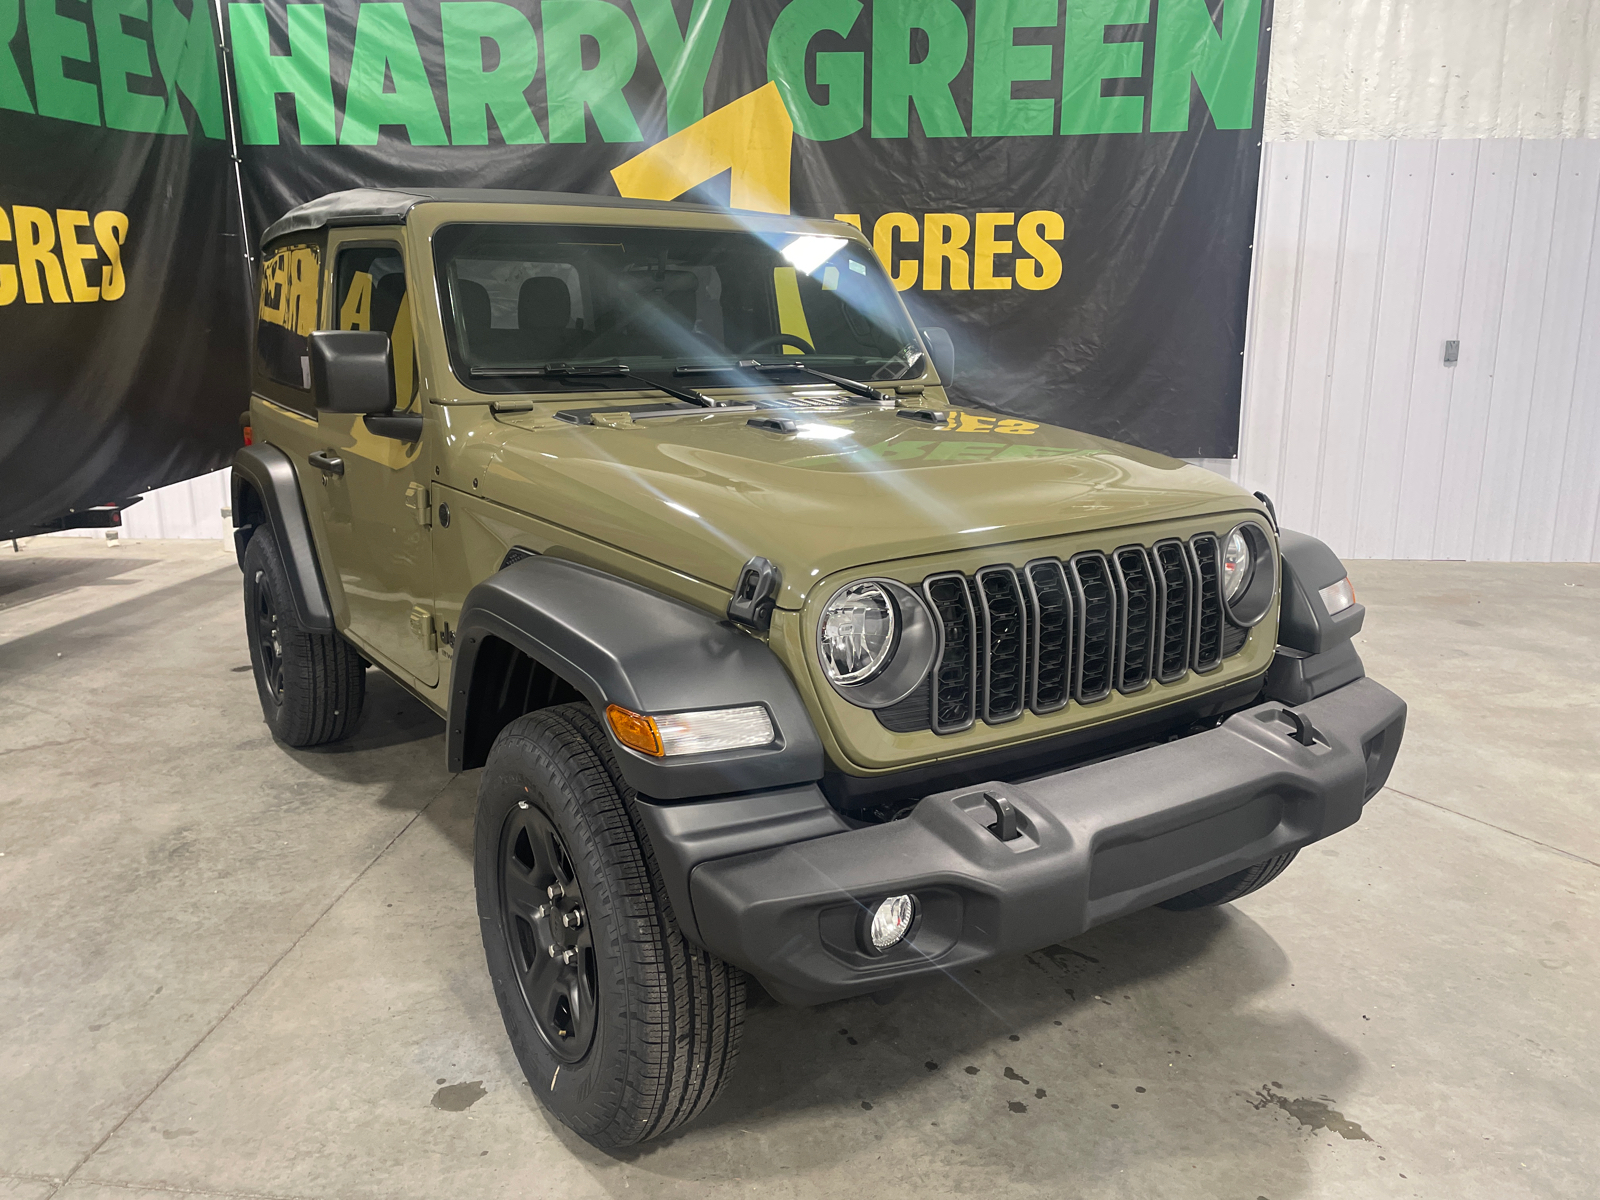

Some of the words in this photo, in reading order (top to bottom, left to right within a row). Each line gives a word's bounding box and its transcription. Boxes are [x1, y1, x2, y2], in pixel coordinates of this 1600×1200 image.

[227, 0, 732, 146] HARRY
[766, 0, 1262, 142] GREEN
[833, 209, 1066, 293] CRES
